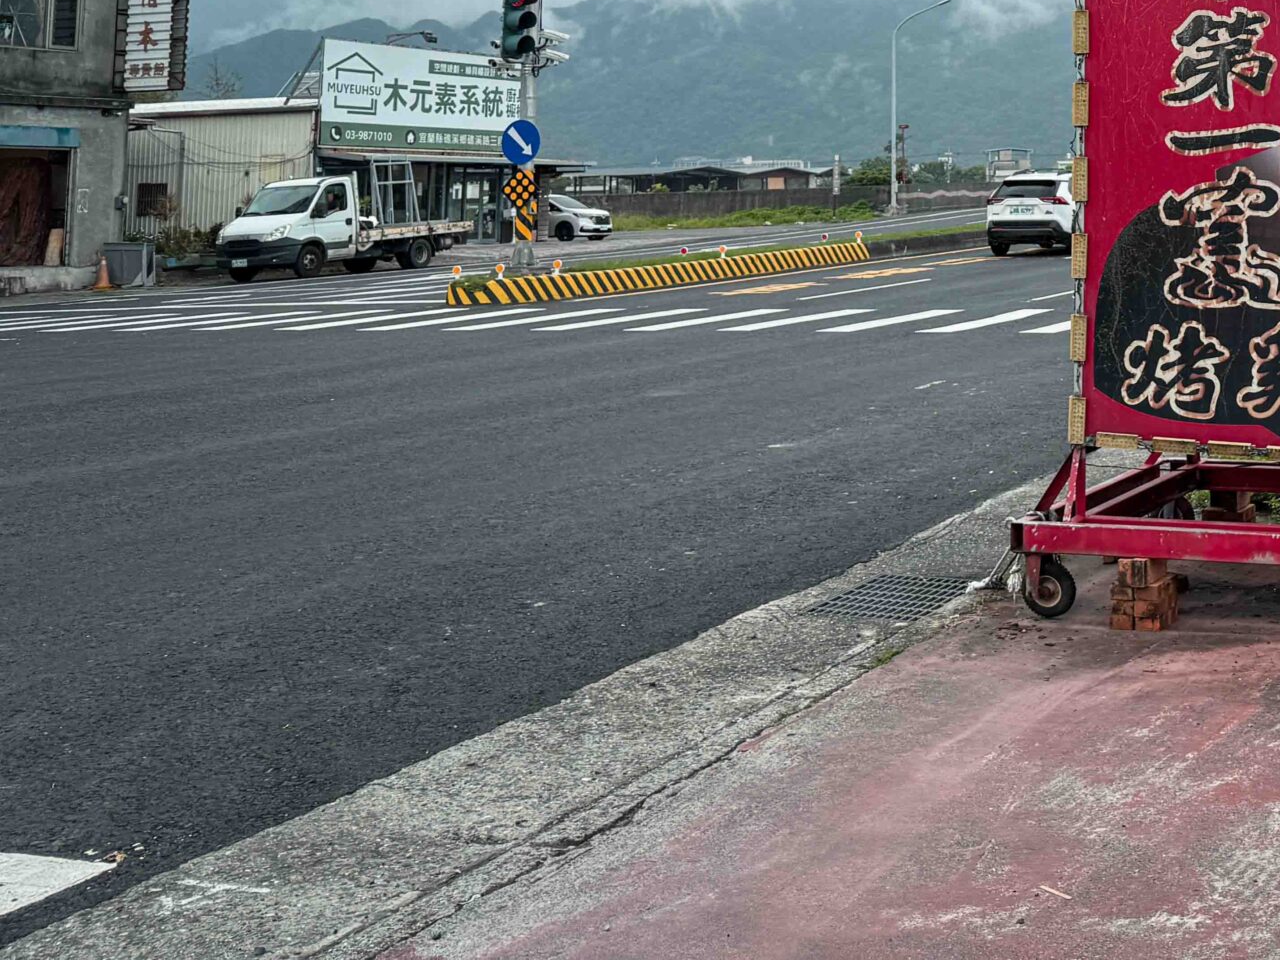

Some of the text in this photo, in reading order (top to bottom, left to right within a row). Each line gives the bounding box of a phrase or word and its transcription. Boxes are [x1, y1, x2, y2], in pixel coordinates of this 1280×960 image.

[327, 82, 381, 96] MUYEUHSU
[383, 78, 503, 118] 木元素系統
[345, 130, 393, 142] 03-9871010
